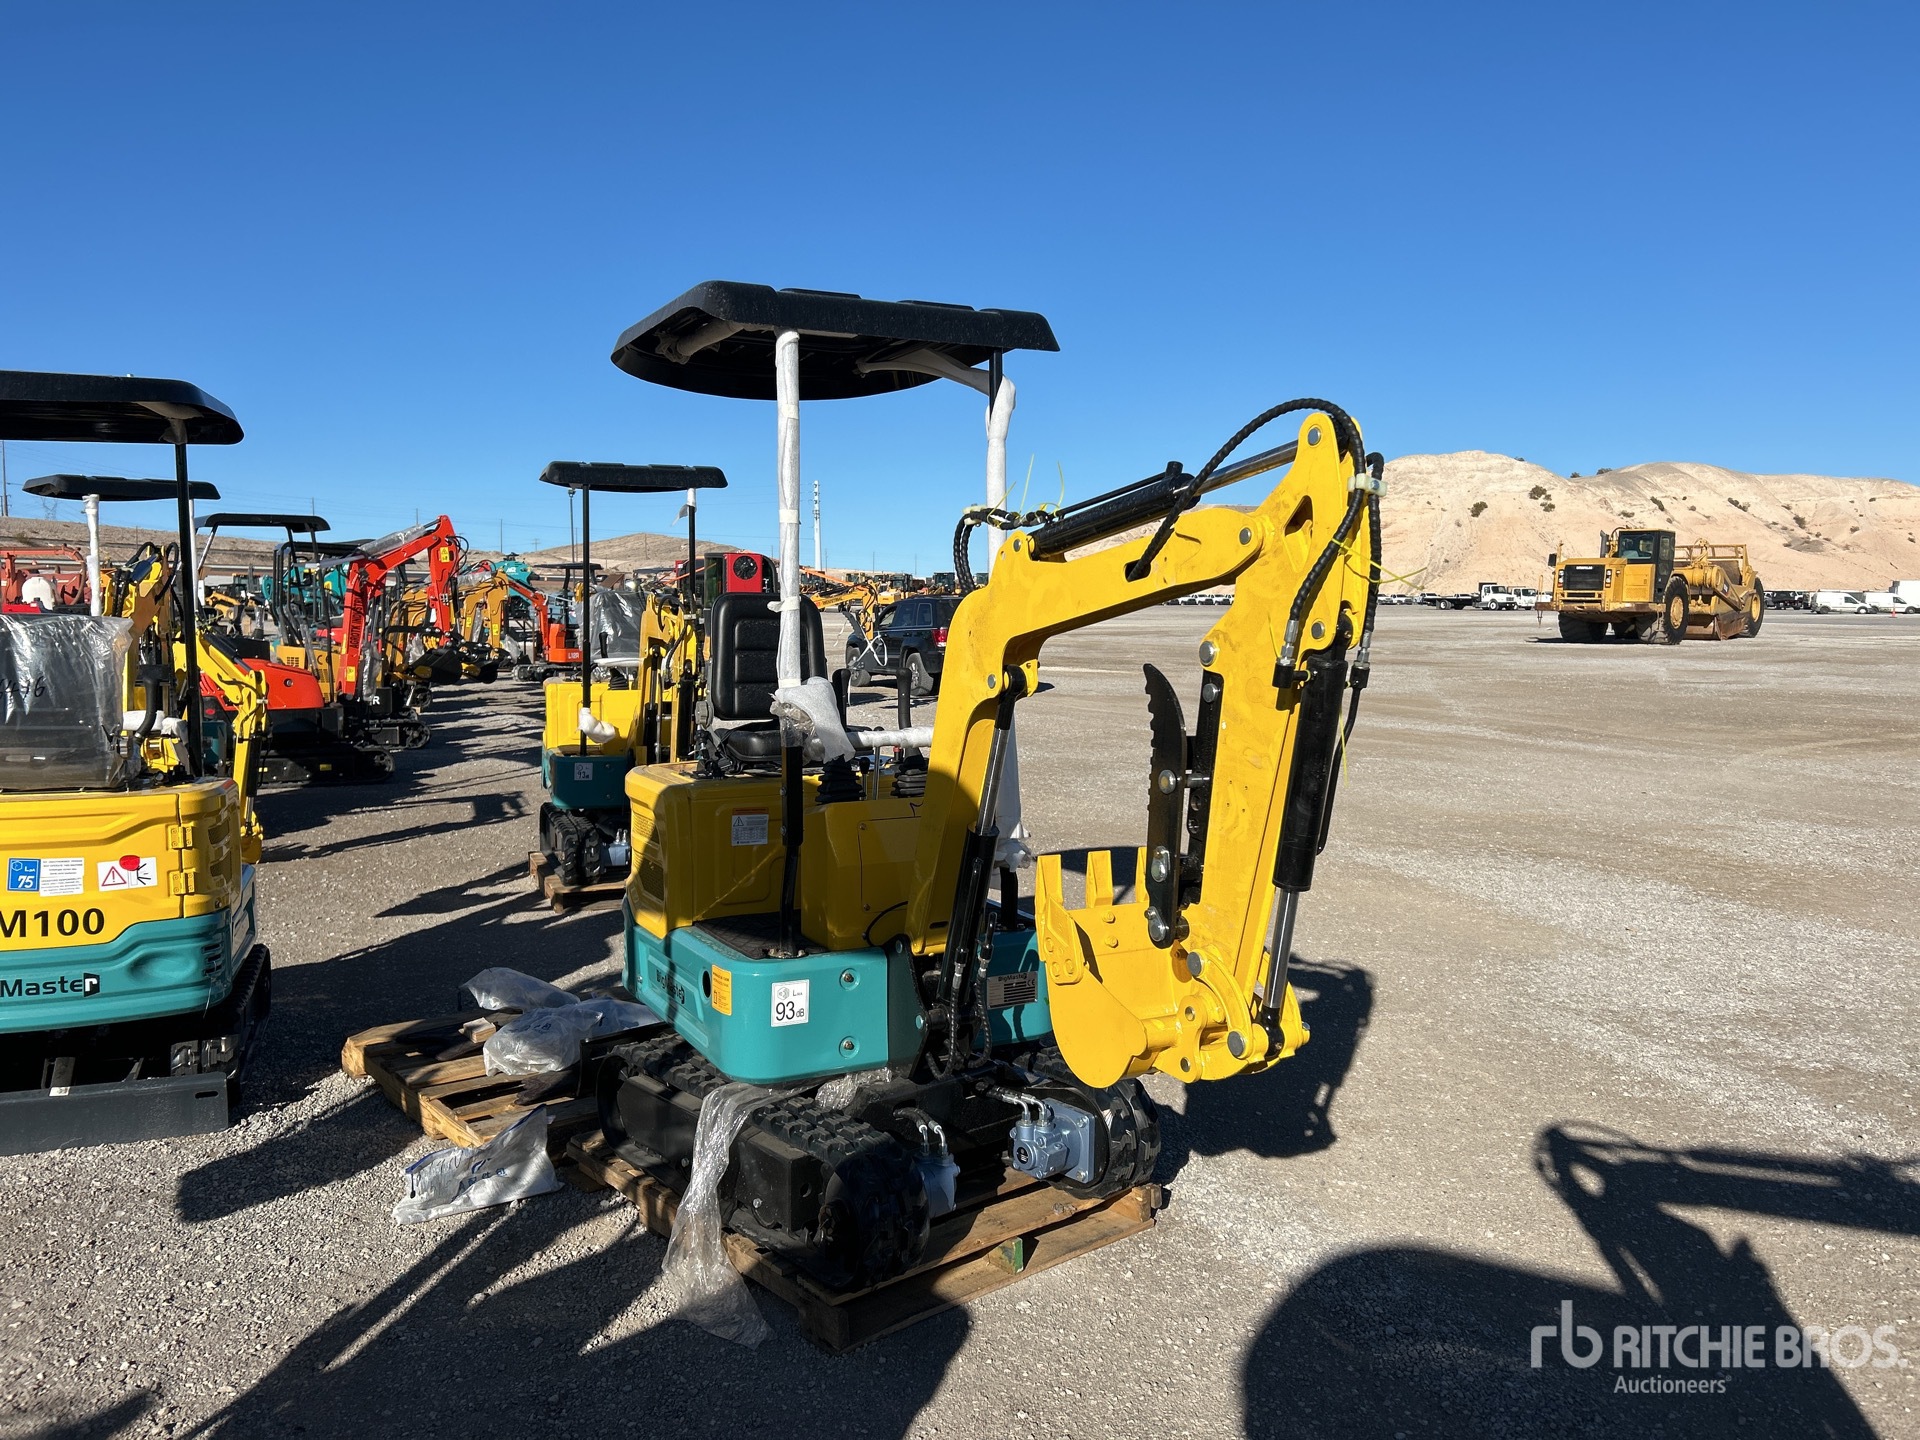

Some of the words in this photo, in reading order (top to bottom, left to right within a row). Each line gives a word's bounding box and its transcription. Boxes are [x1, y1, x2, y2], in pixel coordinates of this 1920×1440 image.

[17, 875, 35, 889] 75
[0, 908, 105, 938] M100
[0, 972, 100, 997] Master
